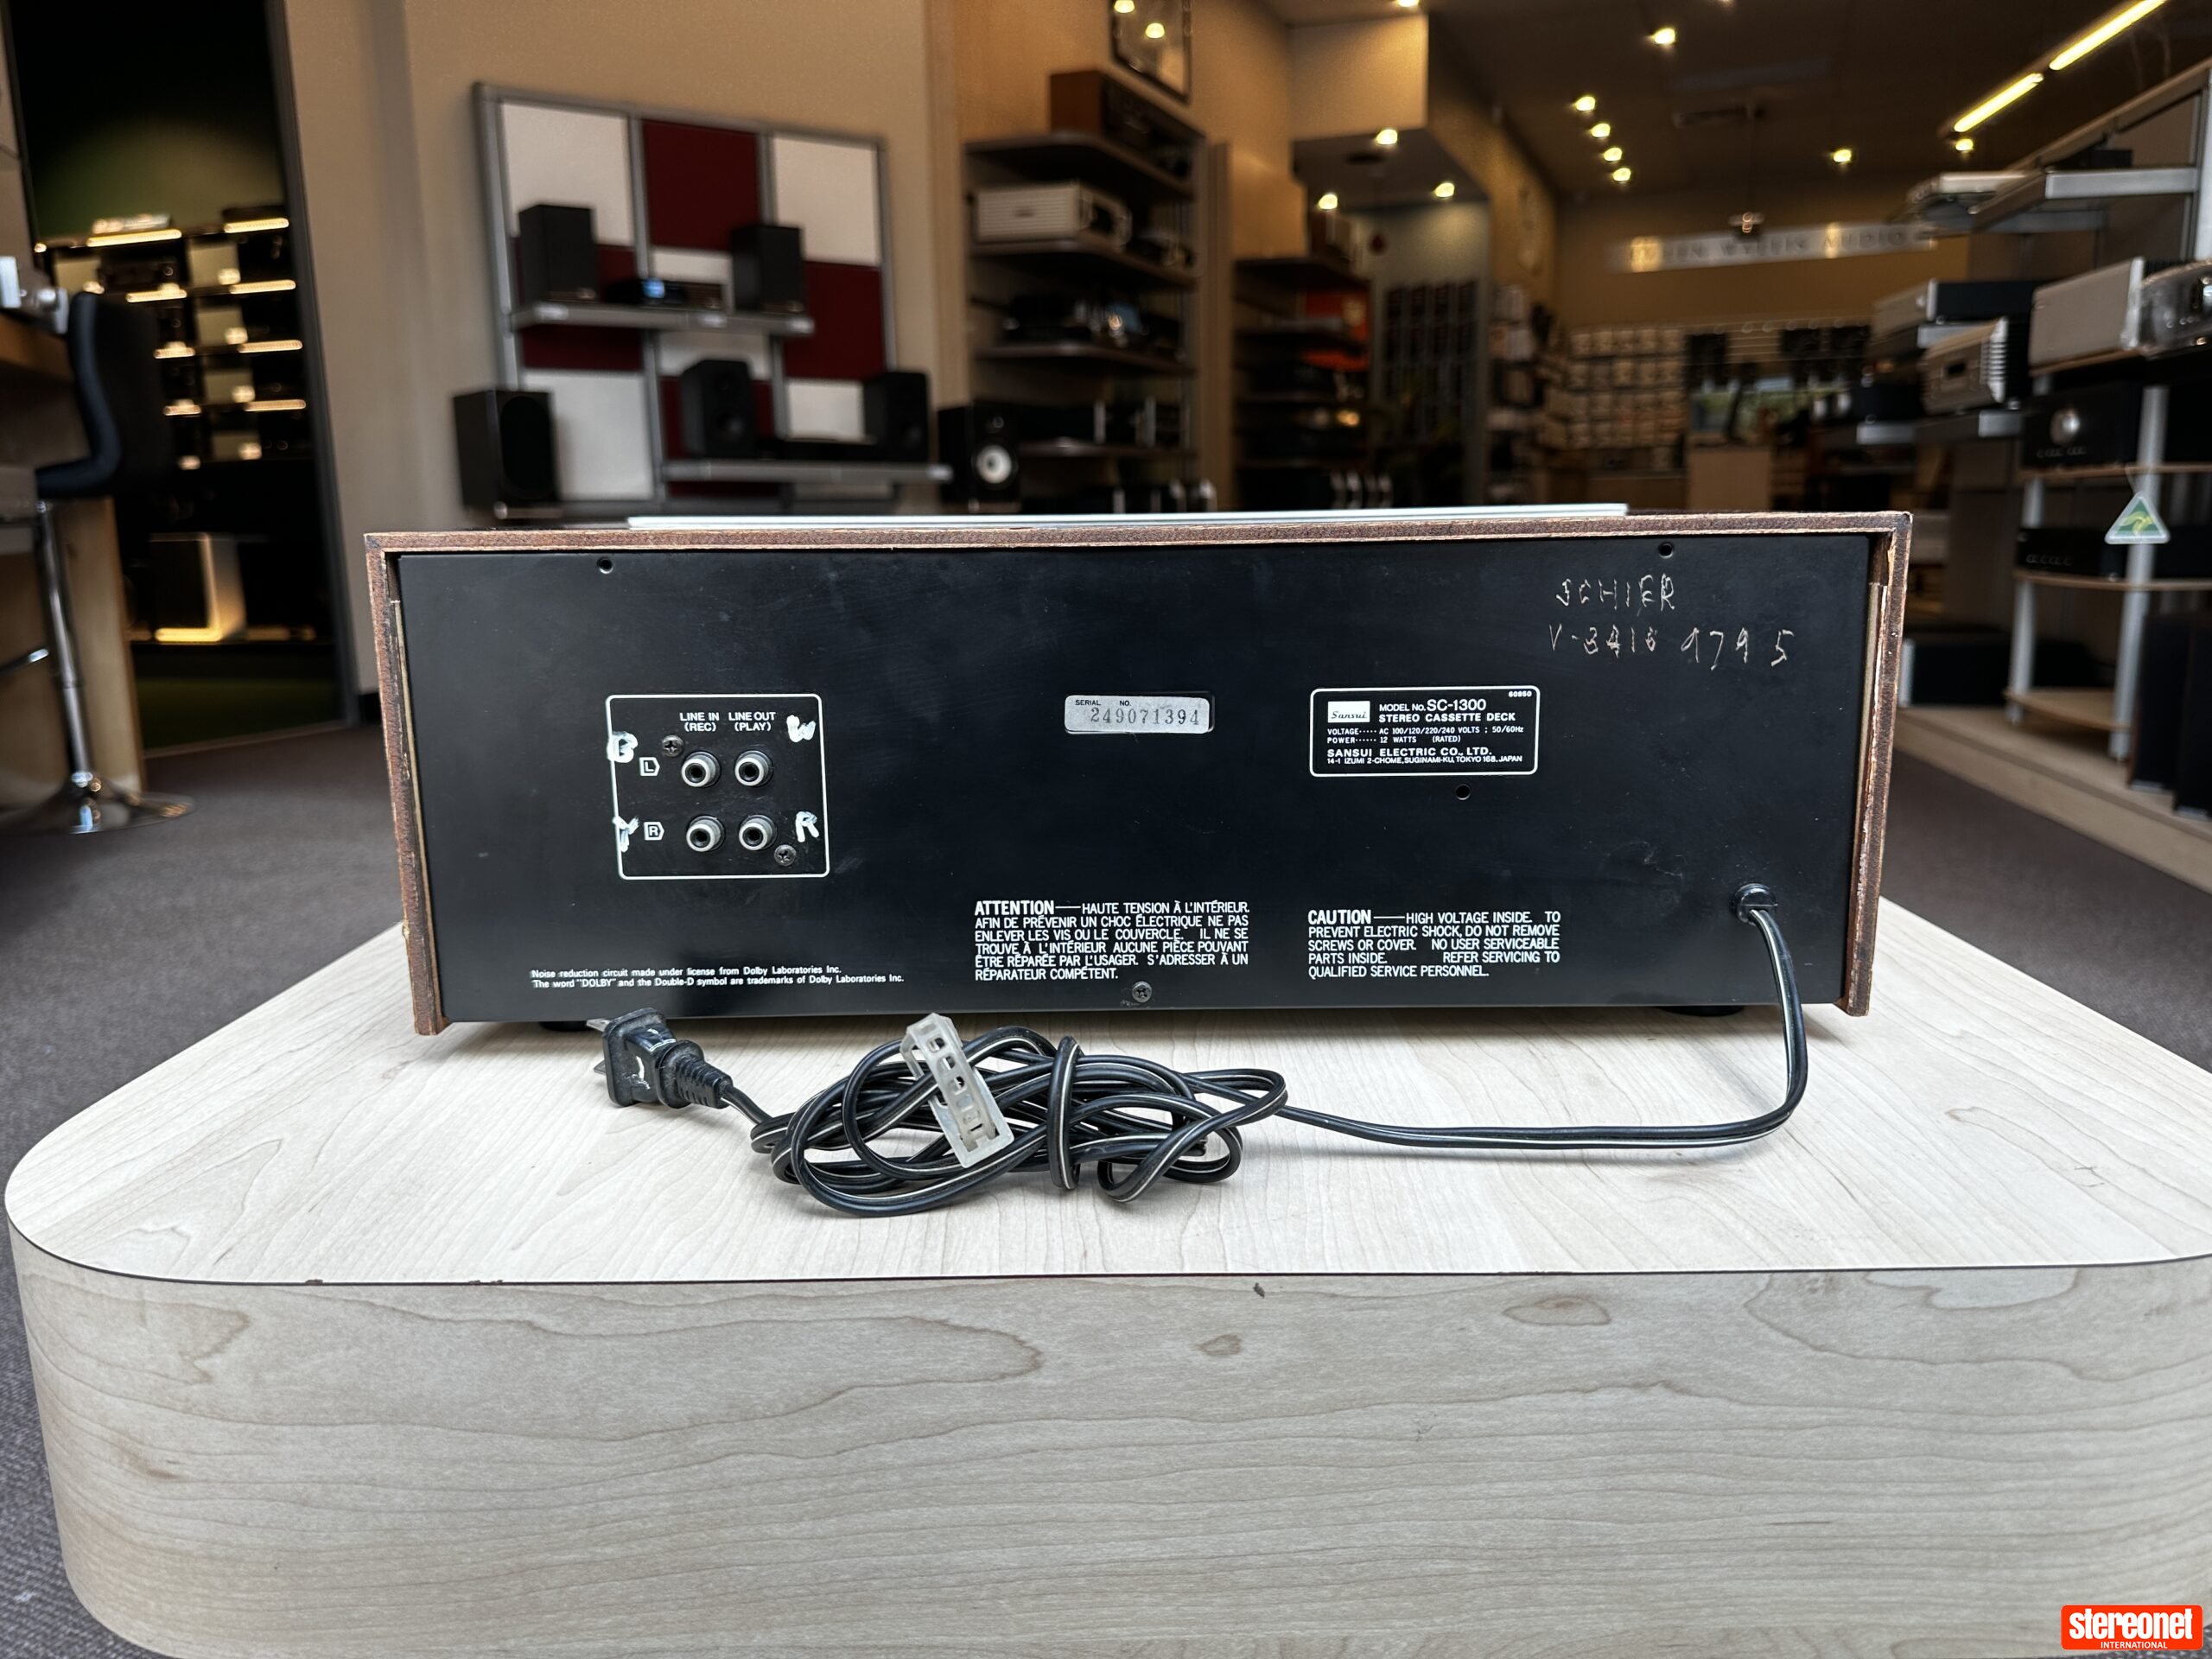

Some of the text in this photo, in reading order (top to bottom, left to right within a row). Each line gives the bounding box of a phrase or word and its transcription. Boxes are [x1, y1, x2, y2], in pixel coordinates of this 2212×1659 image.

[1379, 703, 1410, 712] MODEL
[1427, 698, 1487, 712] SC-1300
[679, 712, 720, 721] LINE IN
[728, 711, 777, 721] LINE OUT
[1090, 707, 1199, 725] 249071394
[1331, 710, 1368, 720] Sansui
[1378, 712, 1516, 723] STEREO CASSETTE DECK
[683, 722, 717, 733] (REC)
[734, 721, 772, 732] (PLAY)
[1392, 726, 1456, 735] 100/120/220/240
[1492, 725, 1524, 734] 50/60Hz
[1432, 734, 1461, 743] (RATED)
[1327, 748, 1373, 758] SANSUI
[1380, 747, 1437, 757] ELECTRIC
[1466, 747, 1492, 756] LTD.
[795, 810, 820, 843] R
[1123, 902, 1169, 914] TENSION
[1173, 899, 1181, 914] À
[1185, 899, 1250, 913] L'INTÉRIEUR.
[975, 913, 1249, 929] AFIN DE PRÉVENIR UN CHOC ÉLECTRIQUE NE PAS
[1438, 912, 1490, 924] VOLTAGE
[1492, 911, 1533, 924] INSIDE.
[1545, 911, 1561, 923] TO
[975, 927, 1249, 942] ENLEVER LES VIS OU LE COUVERCLE. IL NE SE
[1308, 924, 1560, 938] PREVENT ELECTRIC SHOCK, DO NOT REMOVE
[976, 943, 1020, 955] TROUVE
[1023, 941, 1032, 955] À
[1113, 941, 1158, 953] AUCUNE
[1162, 939, 1195, 953] PIÈCE
[1198, 941, 1249, 953] POUVANT
[1308, 938, 1560, 951] SCREWS OR COVER. NO USER SERVICEABLE
[975, 952, 1249, 968] ÊTRE RÉPARÉE PAR L'USAGER. S'ADRESSER À UN
[1308, 950, 1560, 964] PARTS INSIDE. REFER SERVICING TO
[530, 964, 842, 978] Noise reduction circuit made under license from Dolby Laboratories Inc.
[975, 966, 1119, 981] RÉPARATEUR COMPÉTENT.
[1308, 965, 1490, 980] QUALIFIED SERVICE PERSONNEL.
[532, 979, 550, 988] The
[552, 979, 575, 988] word
[637, 978, 652, 987] the
[654, 977, 695, 987] Double-D
[696, 976, 728, 988] symbol
[729, 977, 744, 986] are
[747, 976, 794, 985] trademarks
[797, 976, 806, 984] of
[809, 976, 833, 985] Dolby
[836, 975, 887, 984] Laboratories
[888, 974, 905, 982] Inc.
